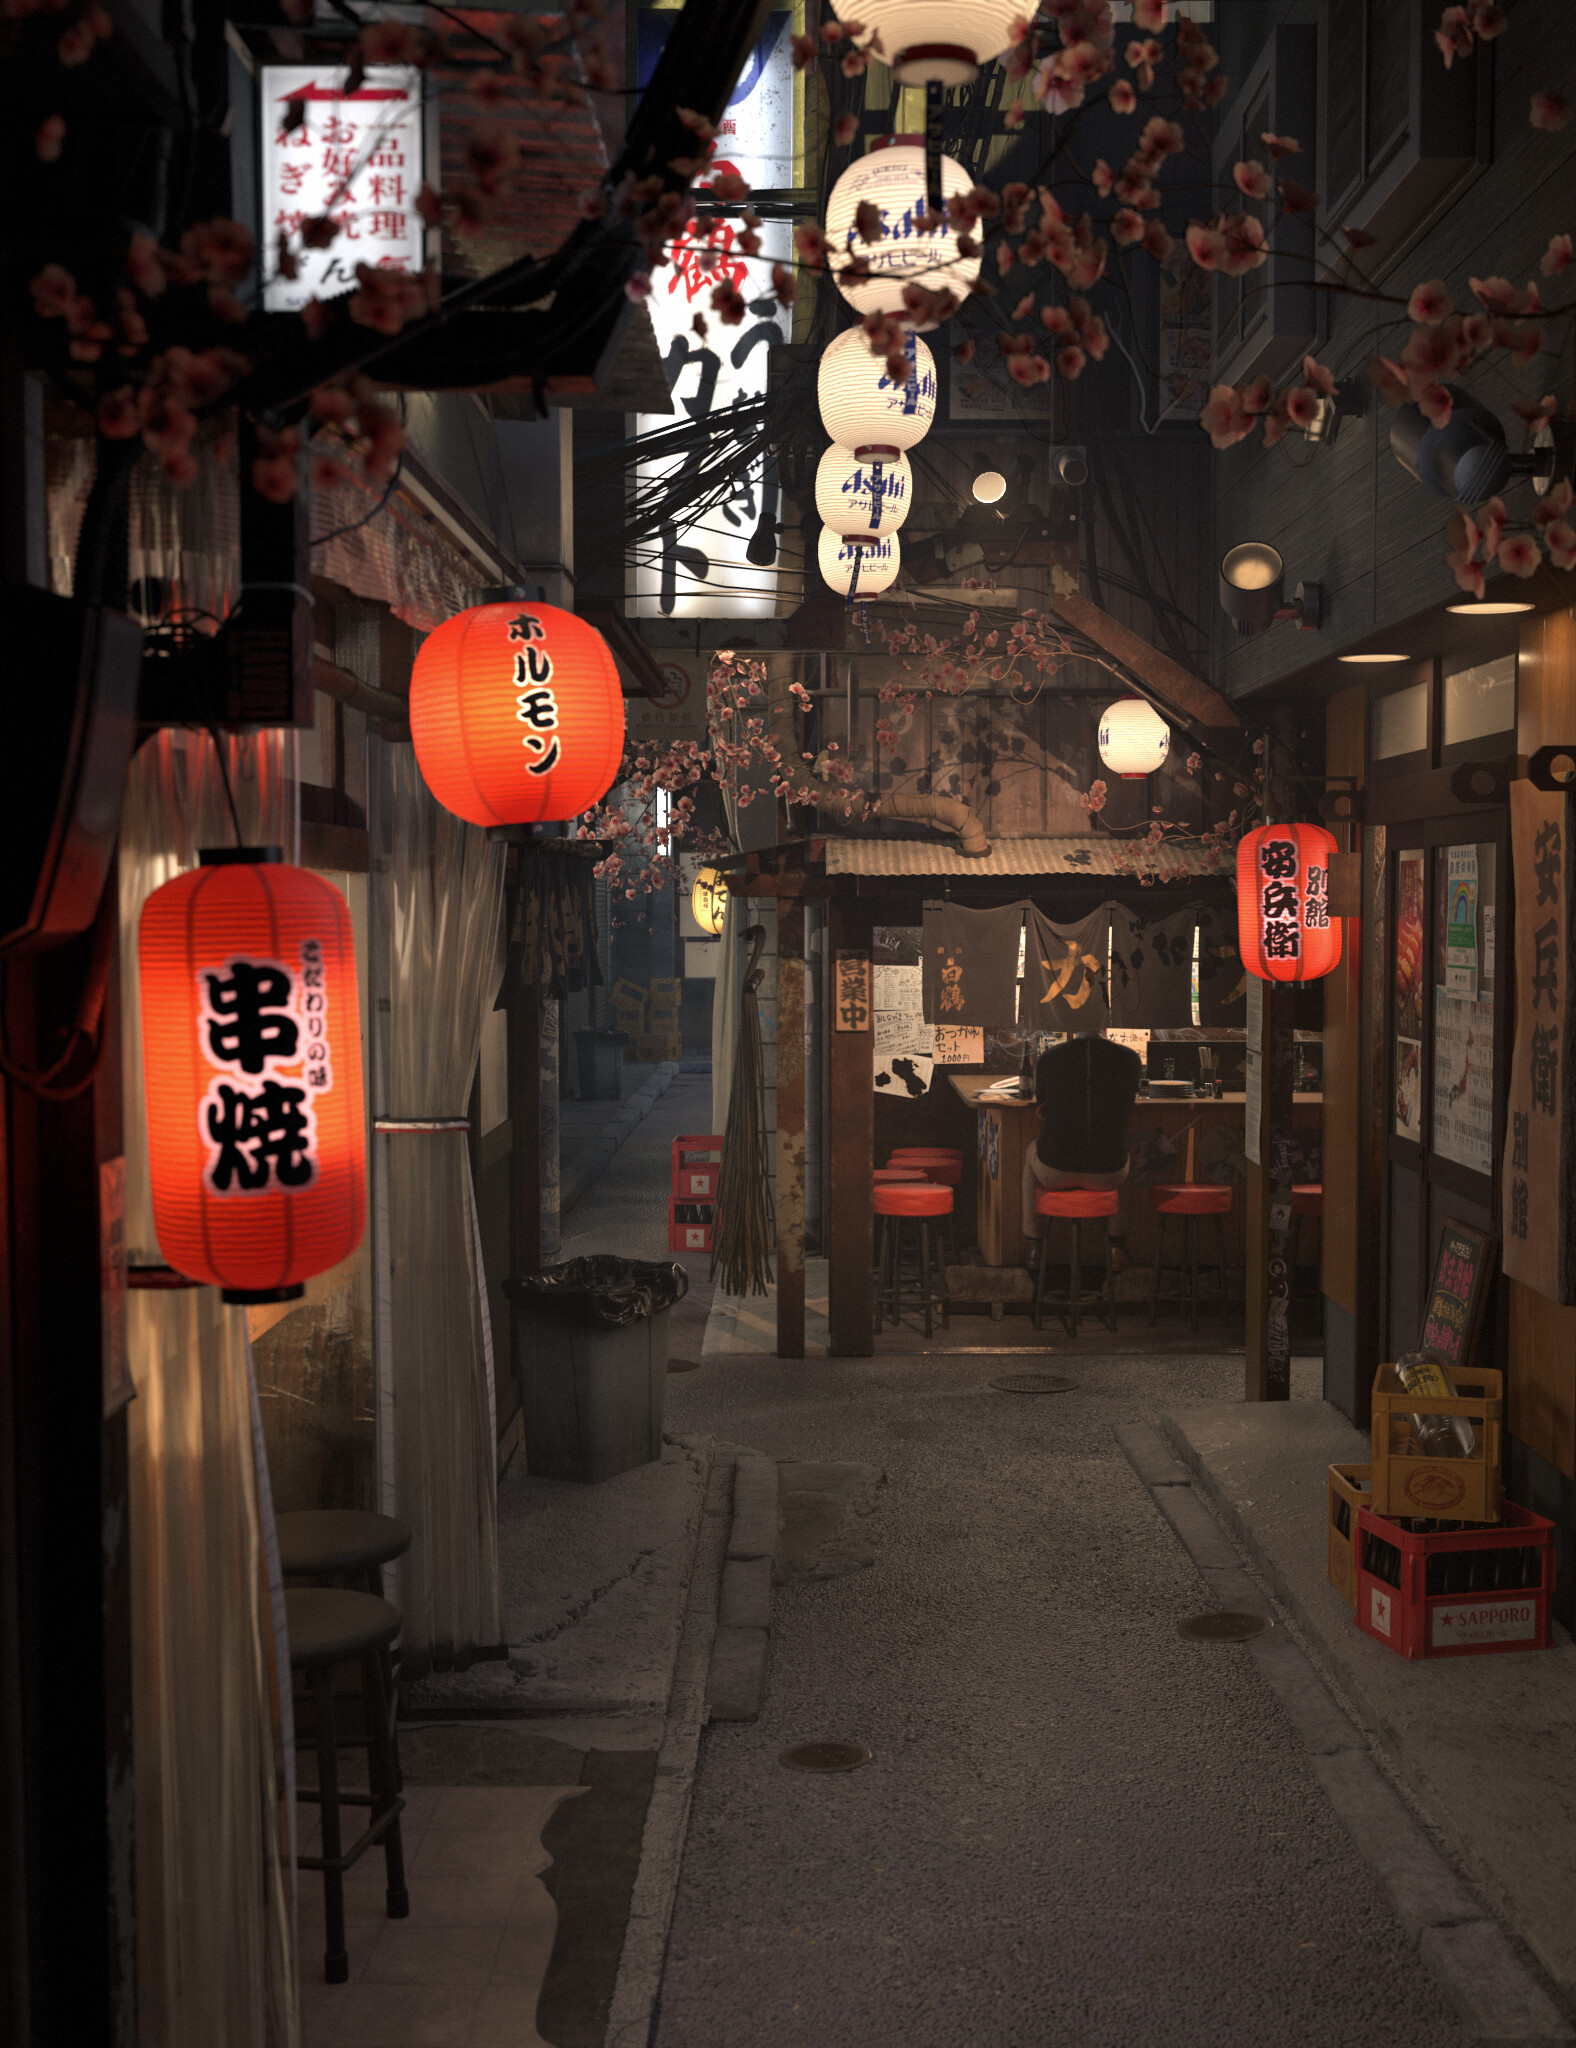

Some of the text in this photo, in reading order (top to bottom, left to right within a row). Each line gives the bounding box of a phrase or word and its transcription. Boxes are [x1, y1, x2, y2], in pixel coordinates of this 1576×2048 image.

[506, 613, 560, 775] ホルモン
[838, 951, 870, 1030] 営業中
[1529, 819, 1562, 1118] 安兵衛
[204, 961, 314, 1192] 串焼
[935, 1041, 961, 1053] セット
[941, 1053, 970, 1064] 1000円
[1510, 1110, 1530, 1241] 別館
[1457, 1606, 1531, 1628] SAPPORO
